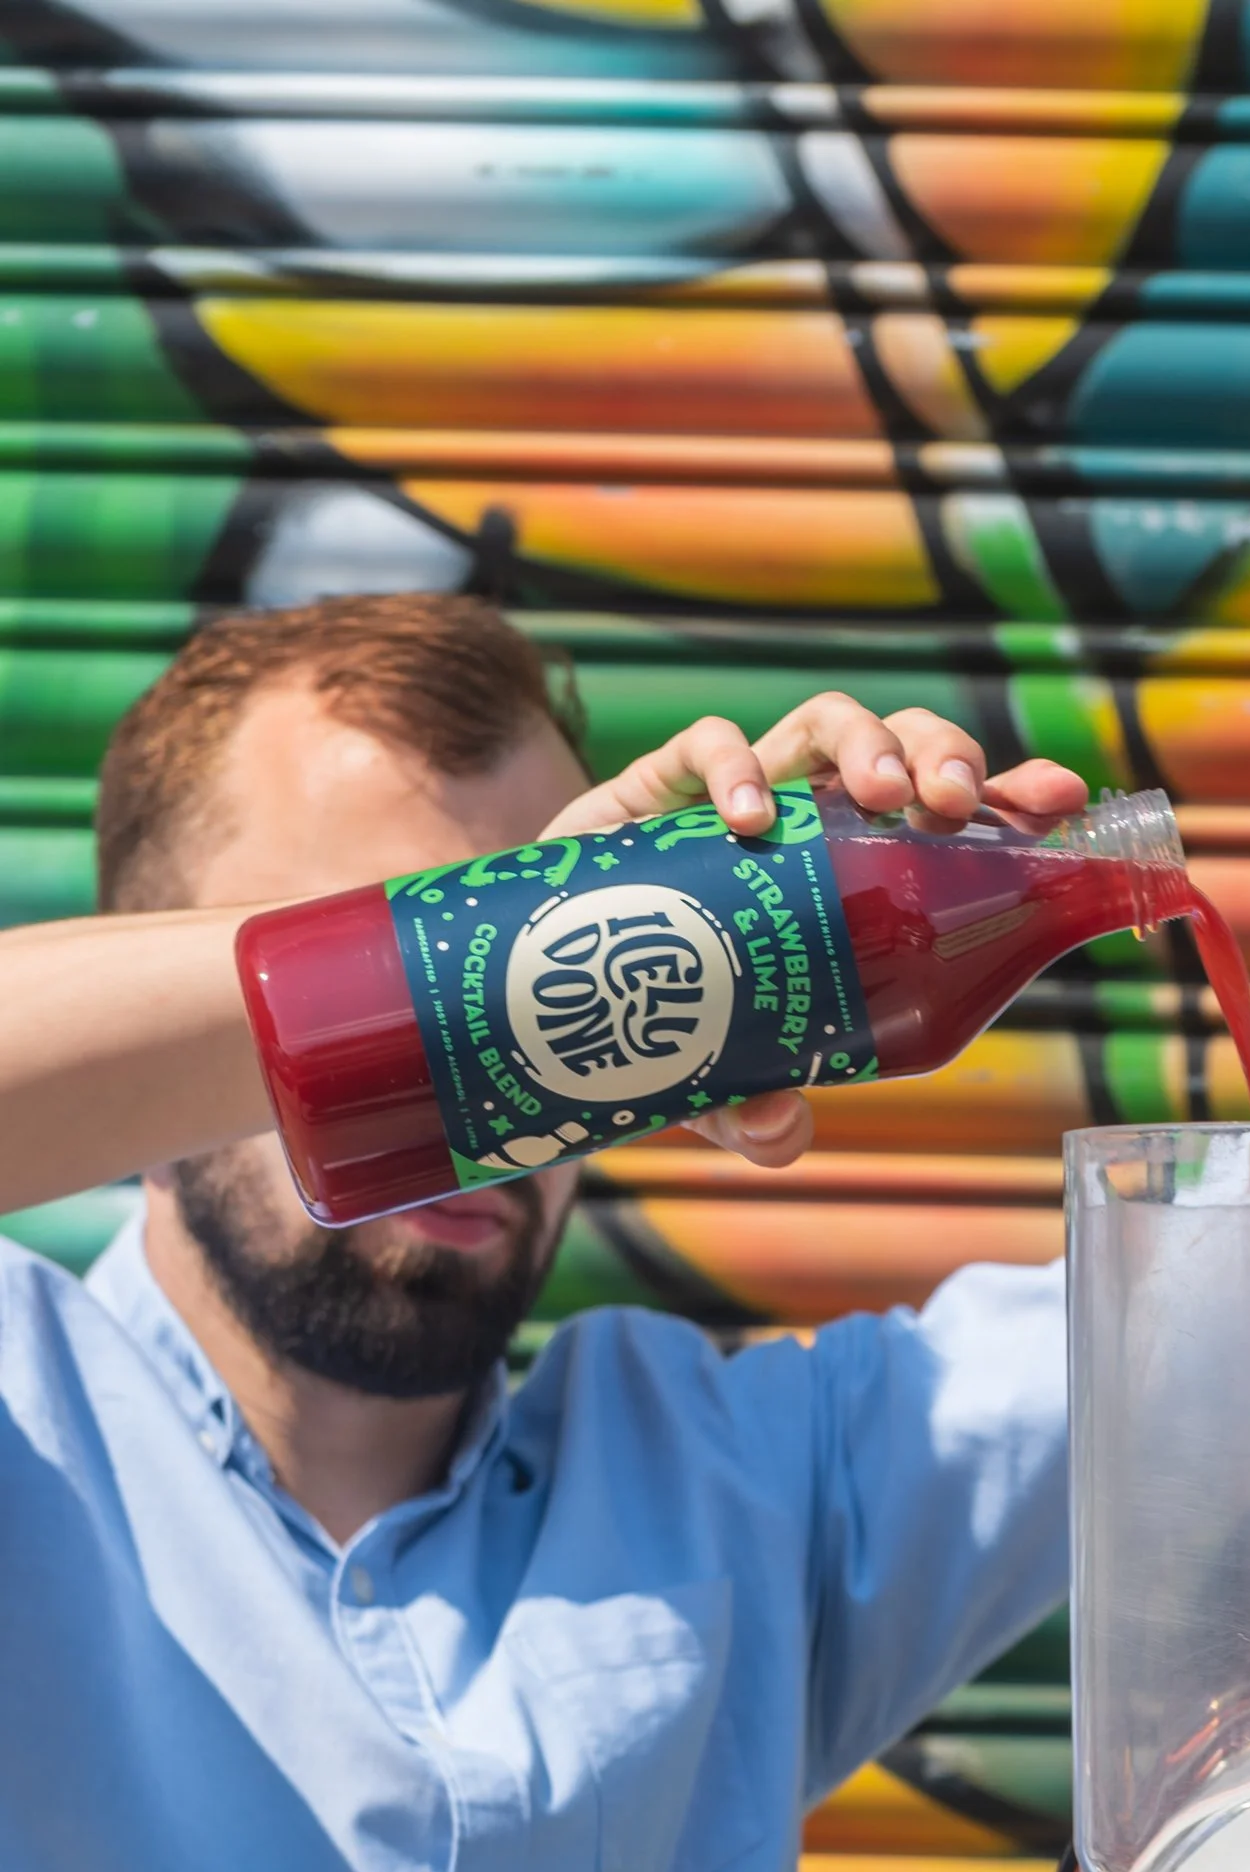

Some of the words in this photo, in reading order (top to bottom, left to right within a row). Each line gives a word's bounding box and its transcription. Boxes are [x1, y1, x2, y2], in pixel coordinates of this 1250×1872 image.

[732, 858, 811, 1055] STRAWBERRY
[733, 908, 759, 936] &
[746, 936, 780, 1012] LIME
[811, 887, 835, 956] SOMETHING
[462, 923, 498, 1046] COCKTAIL
[532, 922, 633, 1077] DONE
[603, 912, 704, 1059] ICELY
[478, 1047, 543, 1116] BLEND
